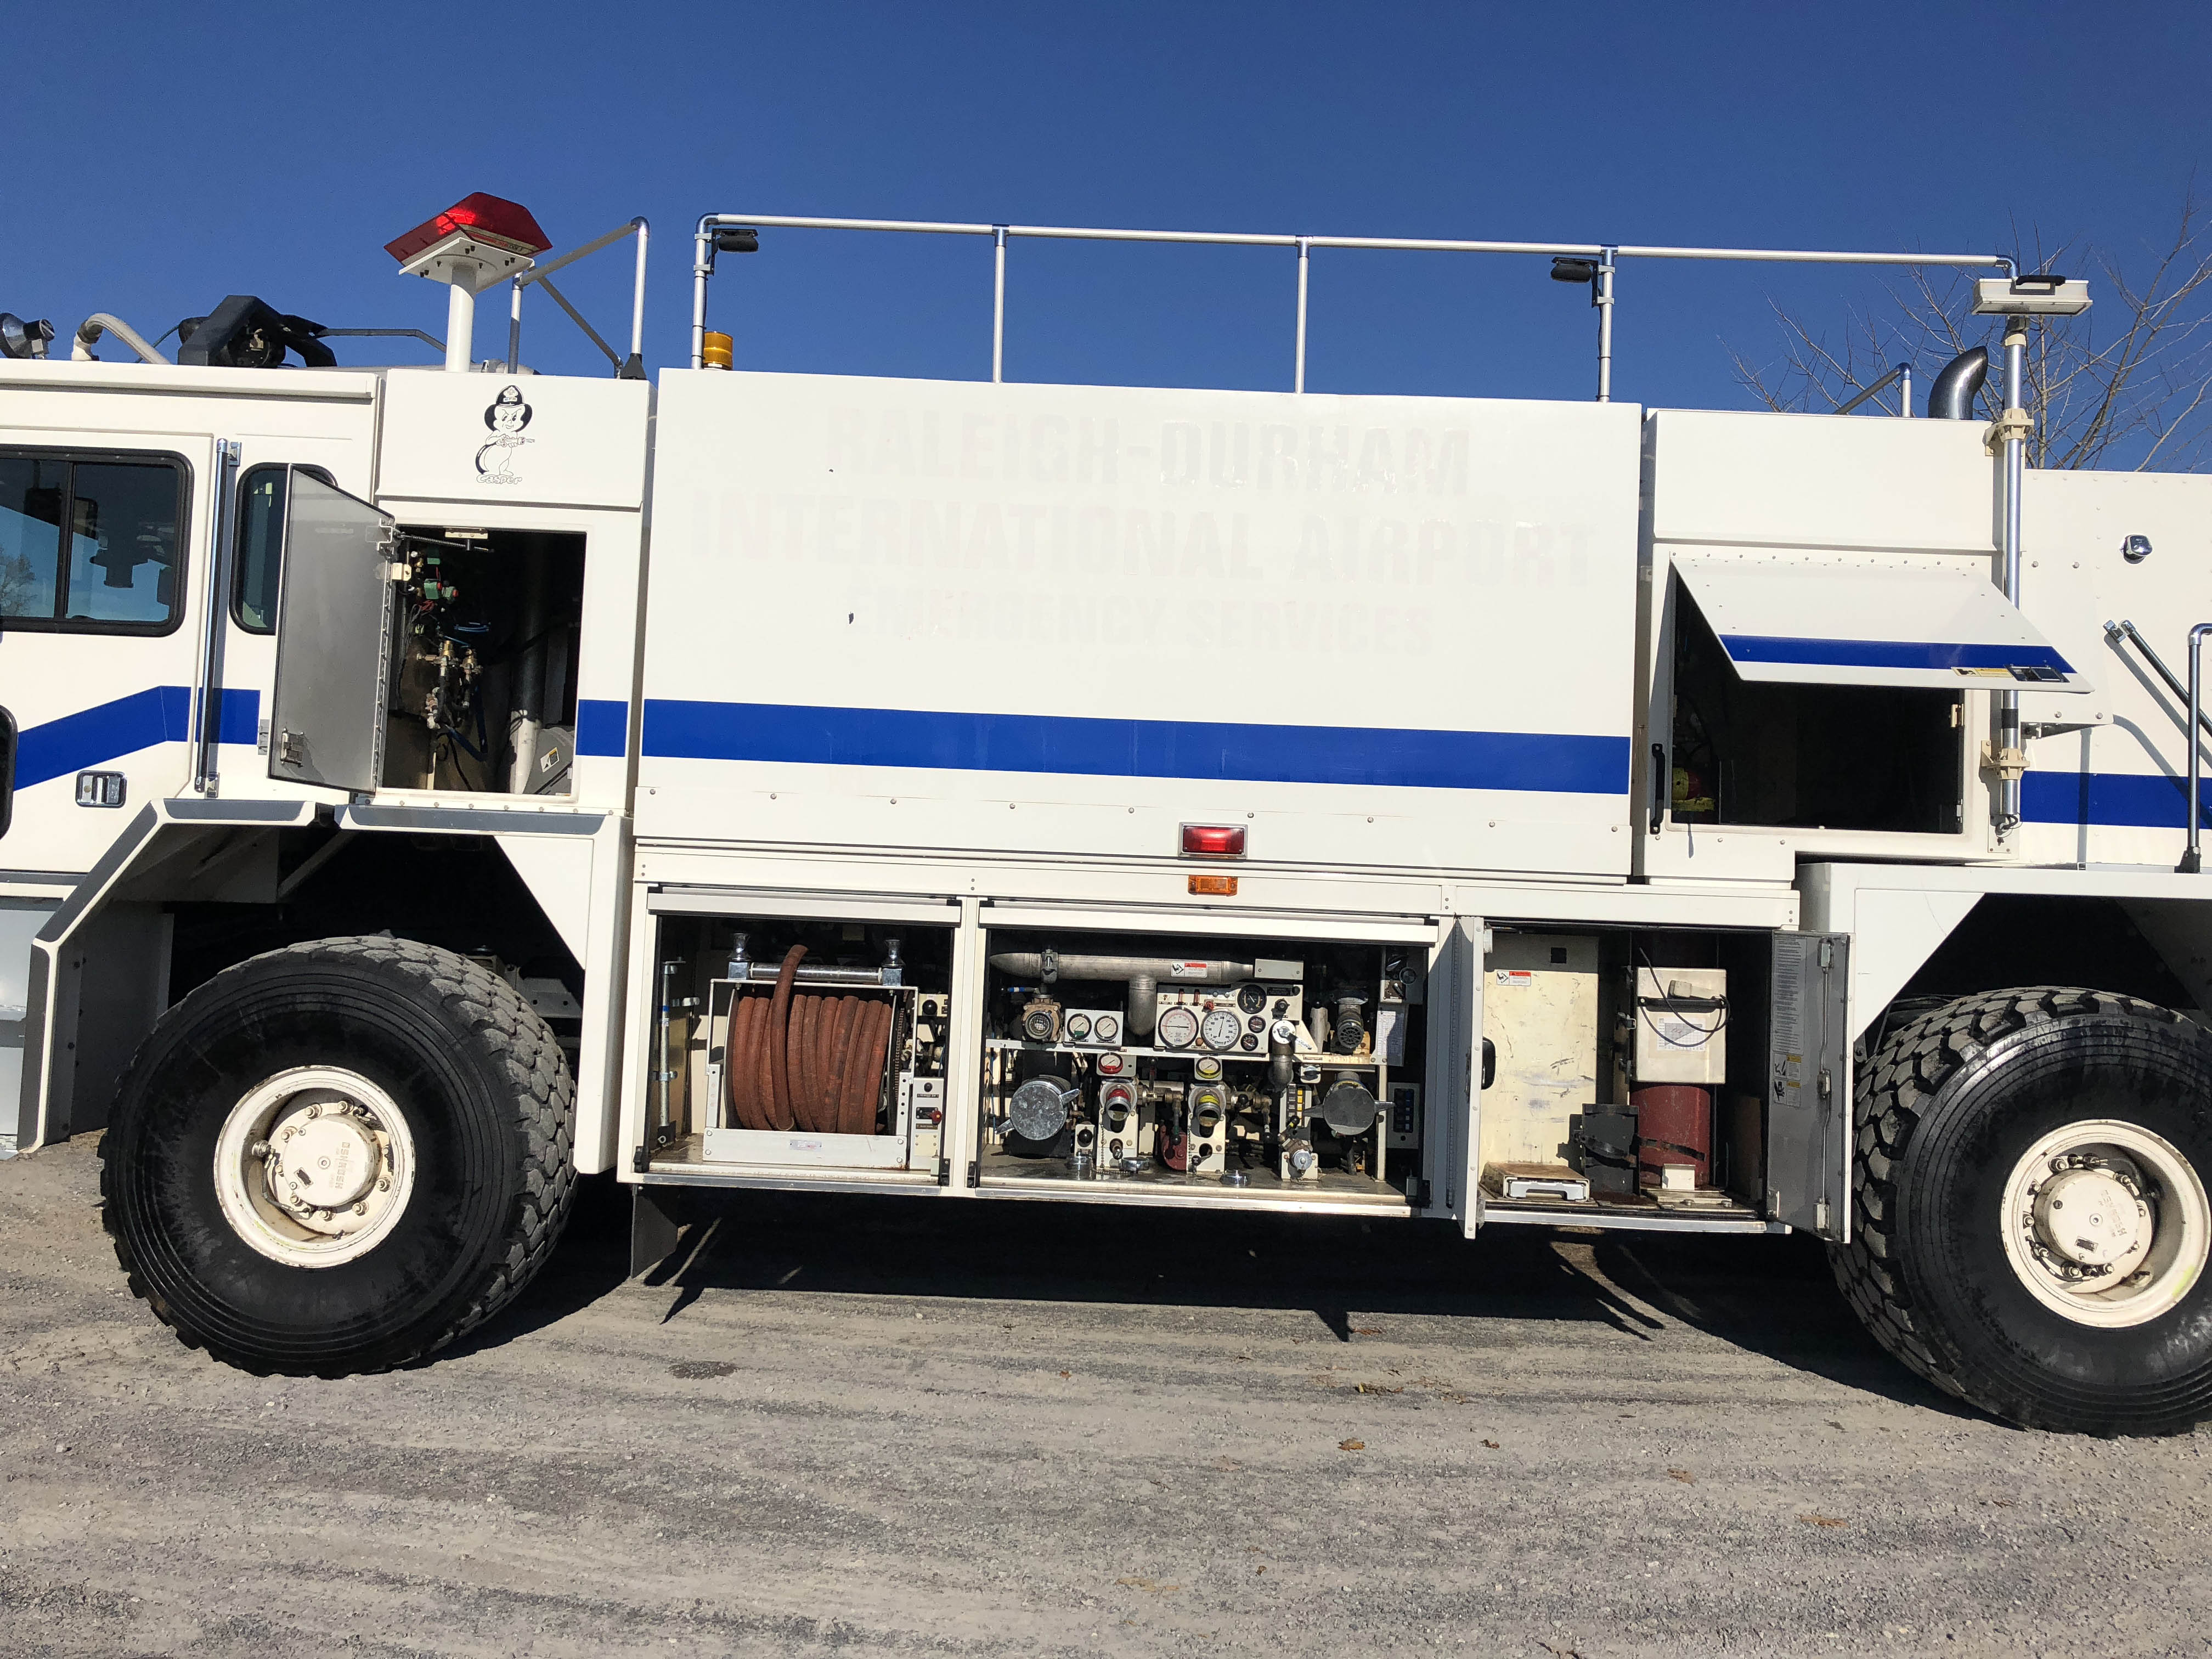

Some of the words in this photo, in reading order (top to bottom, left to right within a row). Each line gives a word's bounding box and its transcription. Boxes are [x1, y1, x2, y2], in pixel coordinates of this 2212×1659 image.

[476, 474, 522, 484] Casper
[826, 405, 1470, 497] RALEIGH-DURHAM
[691, 488, 1263, 580] INTERNATIONAL
[1293, 515, 1600, 588] AIRPORT
[844, 585, 1170, 645] EMERGENCY
[1185, 598, 1433, 657] SERVICES
